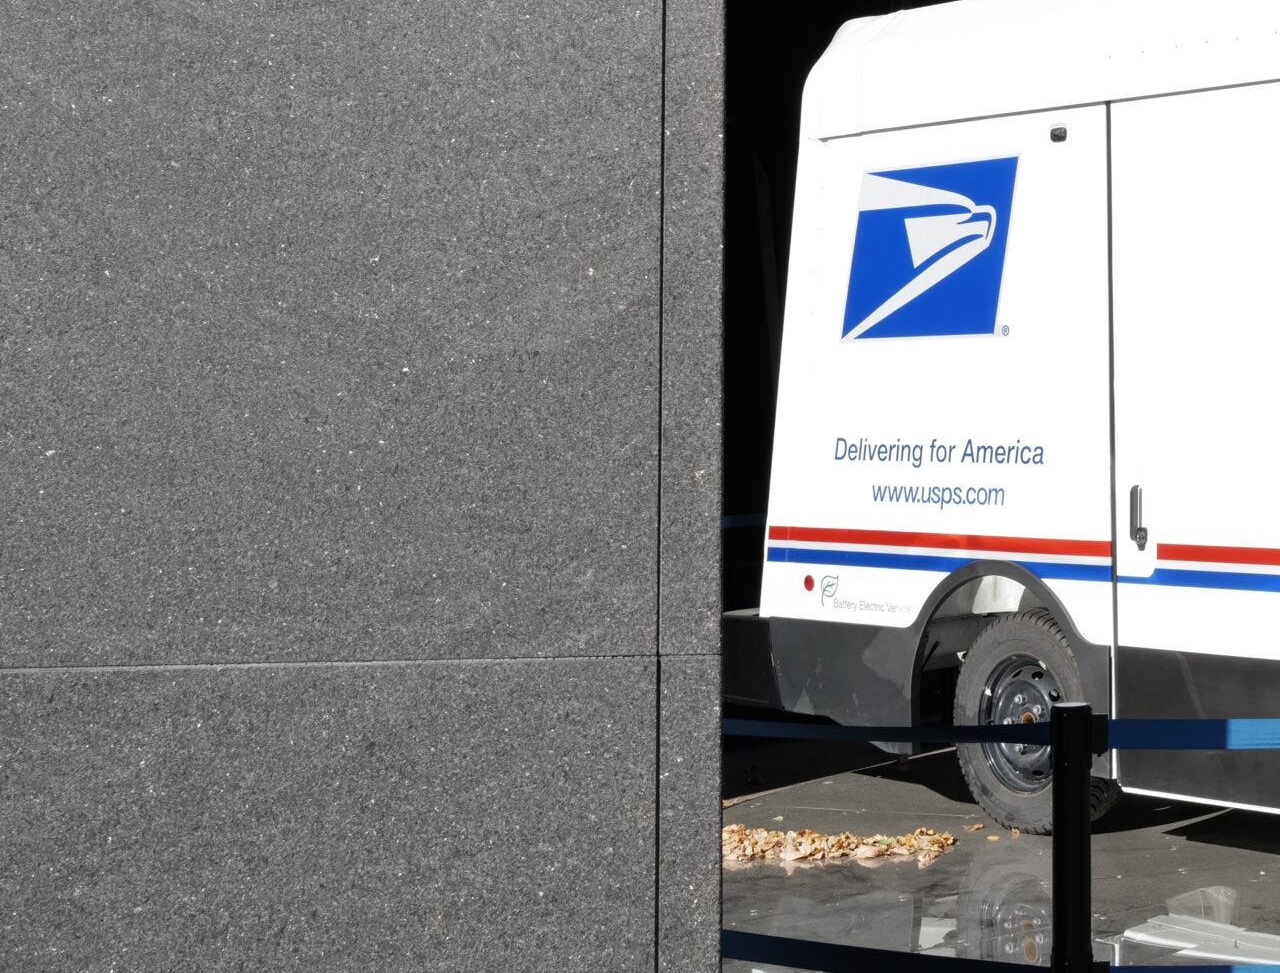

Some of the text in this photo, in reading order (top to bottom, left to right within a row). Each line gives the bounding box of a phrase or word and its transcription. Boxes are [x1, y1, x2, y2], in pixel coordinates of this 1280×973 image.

[834, 437, 1045, 468] Delivering for America
[872, 485, 1005, 510] www.usps.com
[859, 600, 885, 612] Electric
